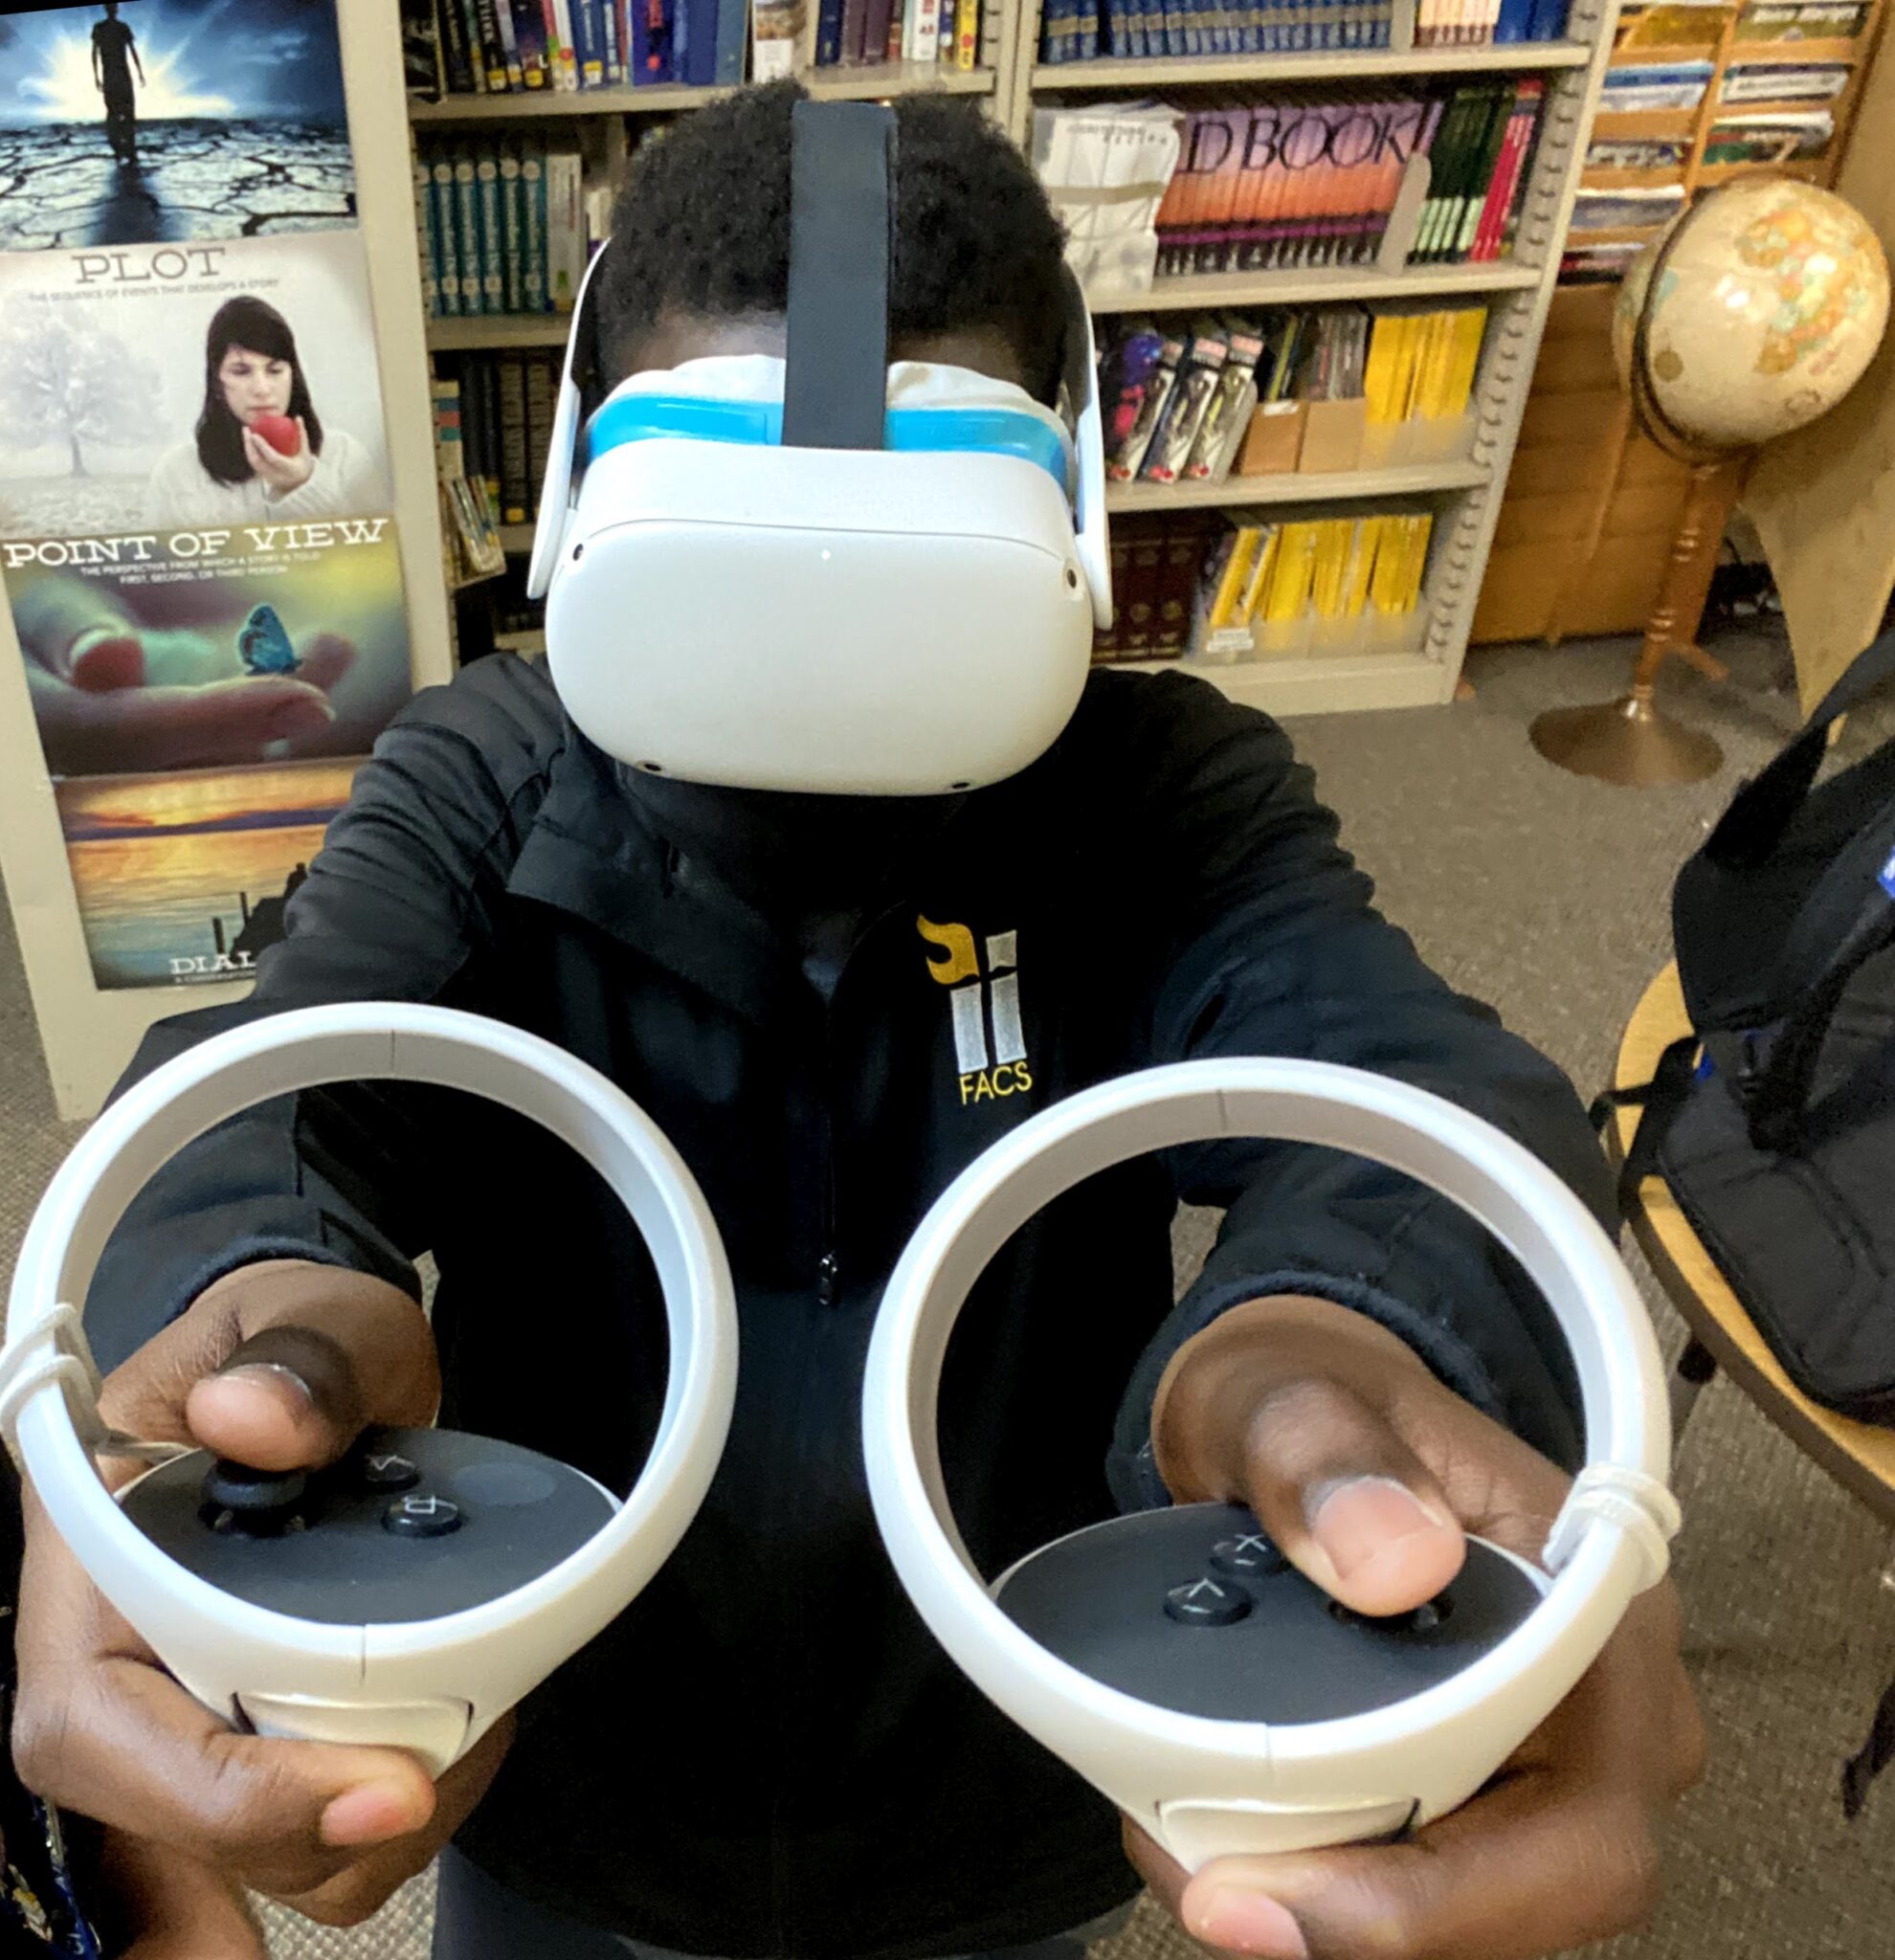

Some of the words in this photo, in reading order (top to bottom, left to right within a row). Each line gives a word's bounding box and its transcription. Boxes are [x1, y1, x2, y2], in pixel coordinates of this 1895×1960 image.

[1174, 119, 1234, 174] D
[1239, 107, 1420, 171] BOOK
[71, 246, 226, 285] PLOT
[3, 535, 157, 568] POINT
[168, 529, 232, 558] OF
[243, 518, 390, 552] VIEW
[168, 950, 256, 975] DIAL
[960, 1060, 1034, 1105] FACS
